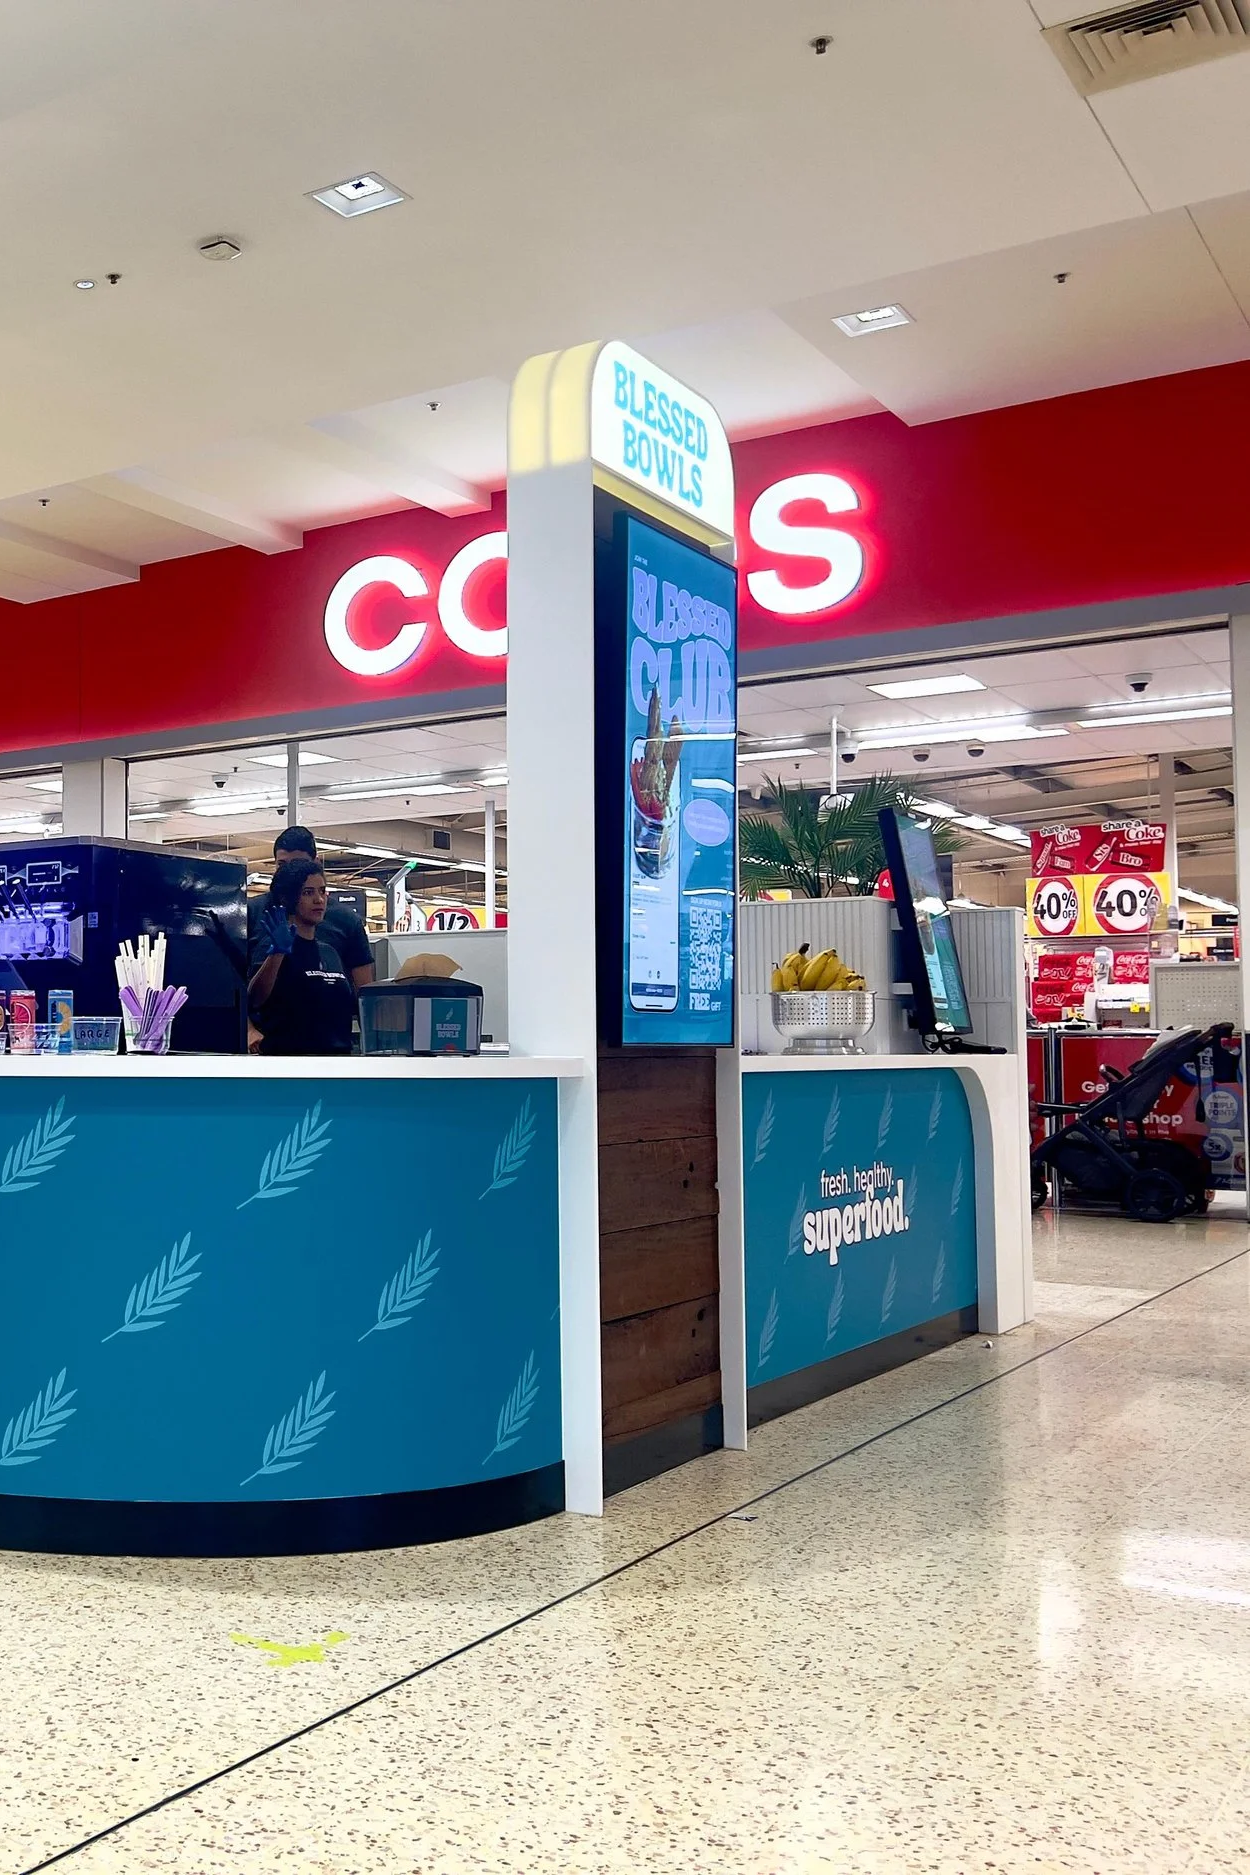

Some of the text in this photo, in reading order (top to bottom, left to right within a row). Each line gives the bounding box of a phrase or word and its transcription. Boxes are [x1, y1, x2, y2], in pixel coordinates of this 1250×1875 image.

[614, 360, 709, 462] BLESSED
[622, 419, 703, 508] BOWLS
[632, 566, 731, 651] BLESSED
[631, 636, 731, 733] CLUB
[1040, 826, 1061, 837] share
[1056, 829, 1080, 845] Coke
[1102, 820, 1142, 832] share a
[1125, 827, 1163, 841] Coke
[1119, 852, 1143, 866] Bro
[1034, 890, 1076, 920] 40%
[1062, 909, 1077, 919] OFF
[1095, 888, 1159, 918] 40%
[435, 912, 471, 931] 1/2
[74, 1029, 110, 1040] LARGE
[820, 1160, 894, 1198] fresh. healthy.
[803, 1178, 910, 1266] superfood.
